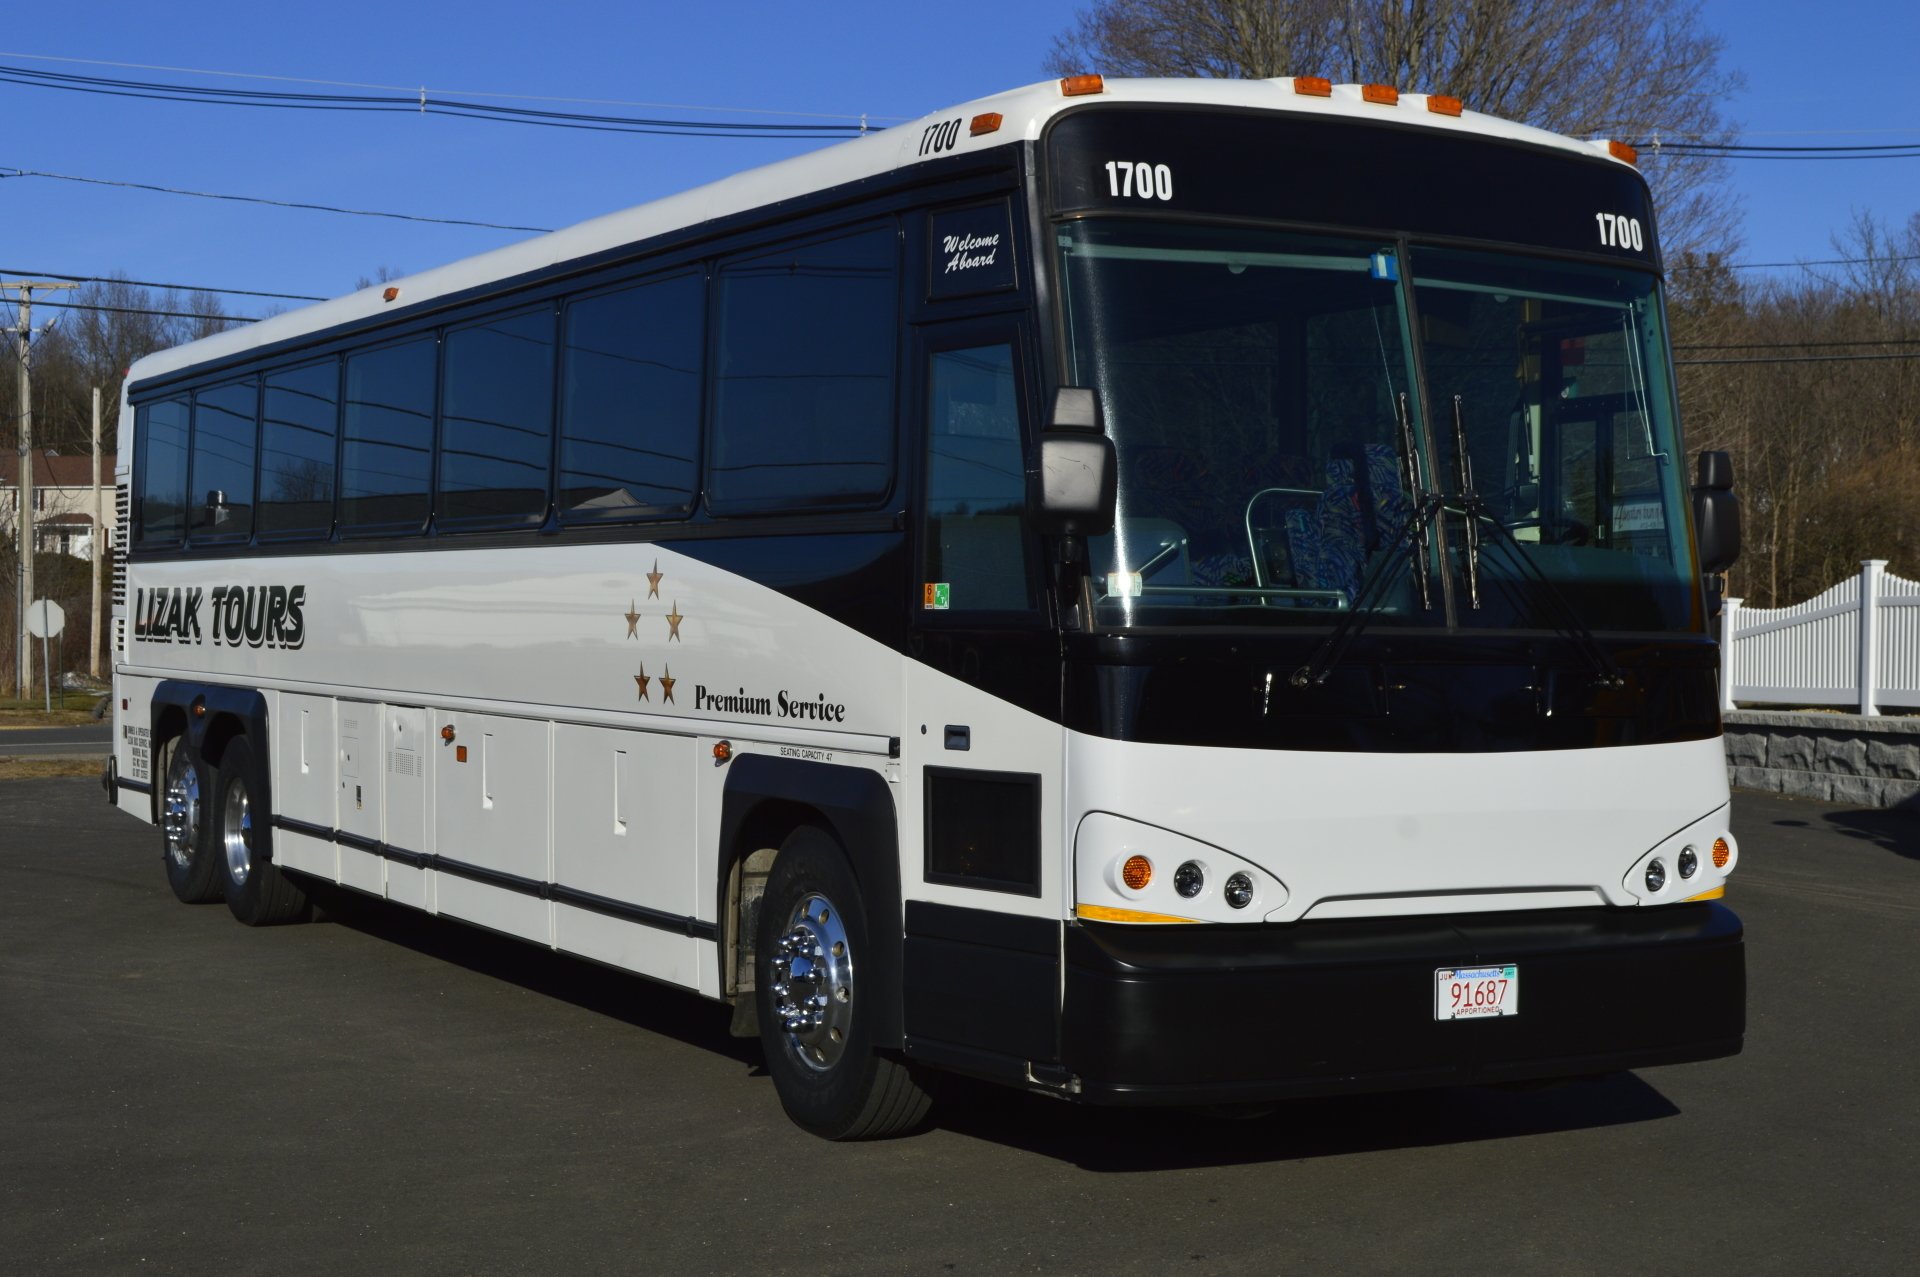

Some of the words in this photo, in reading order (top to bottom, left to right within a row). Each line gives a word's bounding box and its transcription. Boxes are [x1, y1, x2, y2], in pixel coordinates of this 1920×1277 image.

[919, 118, 962, 157] 1700
[1105, 161, 1173, 201] 1700
[943, 233, 999, 253] Welcome
[1595, 212, 1643, 252] 1700
[945, 248, 996, 274] Aboard
[135, 587, 203, 645] LIZAK
[212, 585, 306, 650] TOURS
[695, 685, 772, 716] Premium
[777, 689, 846, 723] Service
[780, 747, 801, 758] SEATING
[802, 749, 825, 761] CAPACITY
[826, 752, 833, 762] 47
[1455, 970, 1500, 979] Massachusetts
[1451, 980, 1508, 1008] 91687
[1456, 1006, 1500, 1016] APPORTIONED
